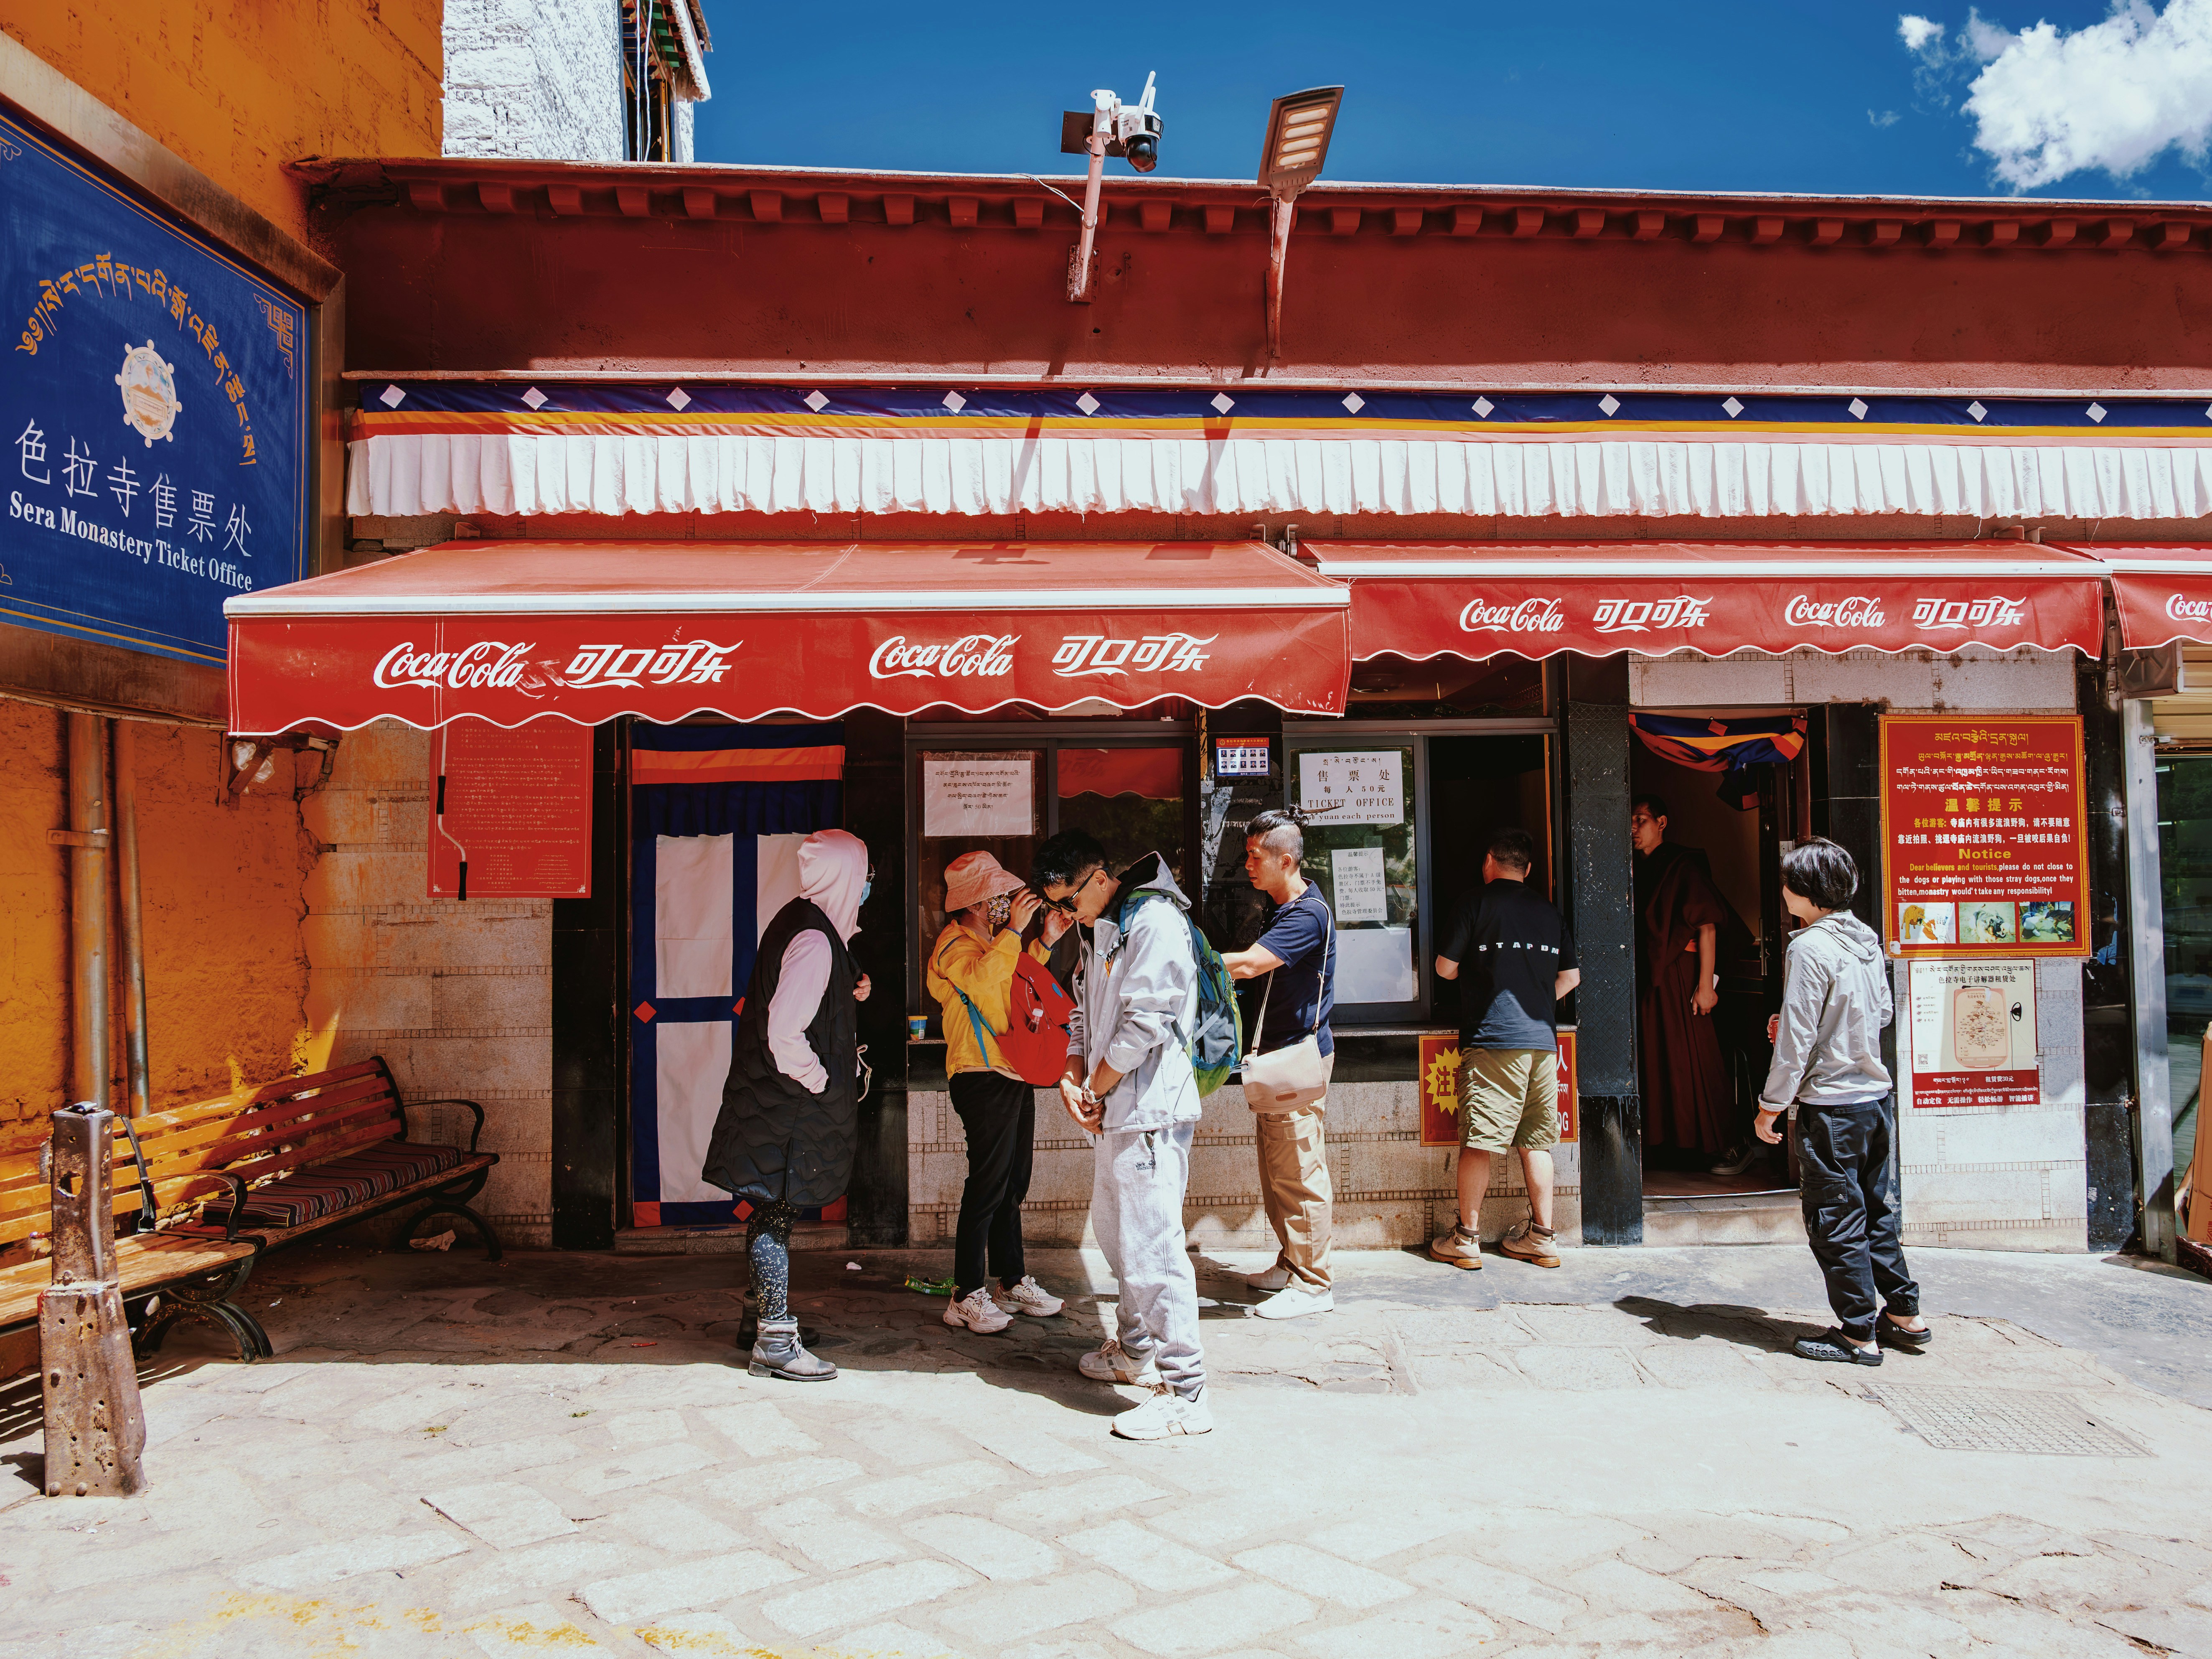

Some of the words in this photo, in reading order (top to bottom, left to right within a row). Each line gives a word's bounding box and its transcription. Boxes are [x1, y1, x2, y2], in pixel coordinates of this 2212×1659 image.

[15, 418, 252, 557] 色拉寺售票处
[10, 491, 56, 529] Sera
[60, 506, 153, 564] Monastery
[156, 539, 205, 577] Ticket
[209, 558, 252, 591] Office
[1459, 598, 1564, 632] Coca-Cola
[1593, 595, 1713, 633] 可口可乐
[1785, 595, 1885, 627] Coca-Cola
[1912, 596, 2026, 629] 可口可乐
[869, 635, 1022, 679] Coca-Cola
[1052, 633, 1219, 677] 可口可乐
[373, 641, 536, 689] Coca-Cola
[565, 640, 743, 689] 可口可乐
[1317, 769, 1390, 782] 售票处
[1308, 799, 1345, 808] TICKET
[1356, 798, 1394, 807] OFFICE
[1945, 798, 2022, 812] 温馨提示
[1959, 849, 2011, 859] Notice
[1925, 863, 1955, 871] believers
[1914, 875, 1930, 885] dogs
[1942, 875, 1965, 885] playing
[2006, 875, 2022, 884] stray
[2059, 874, 2073, 883] they
[1939, 975, 2016, 984] 色拉寺电子讲解器租赁处
[1978, 1095, 2003, 1104] 轻松畅游
